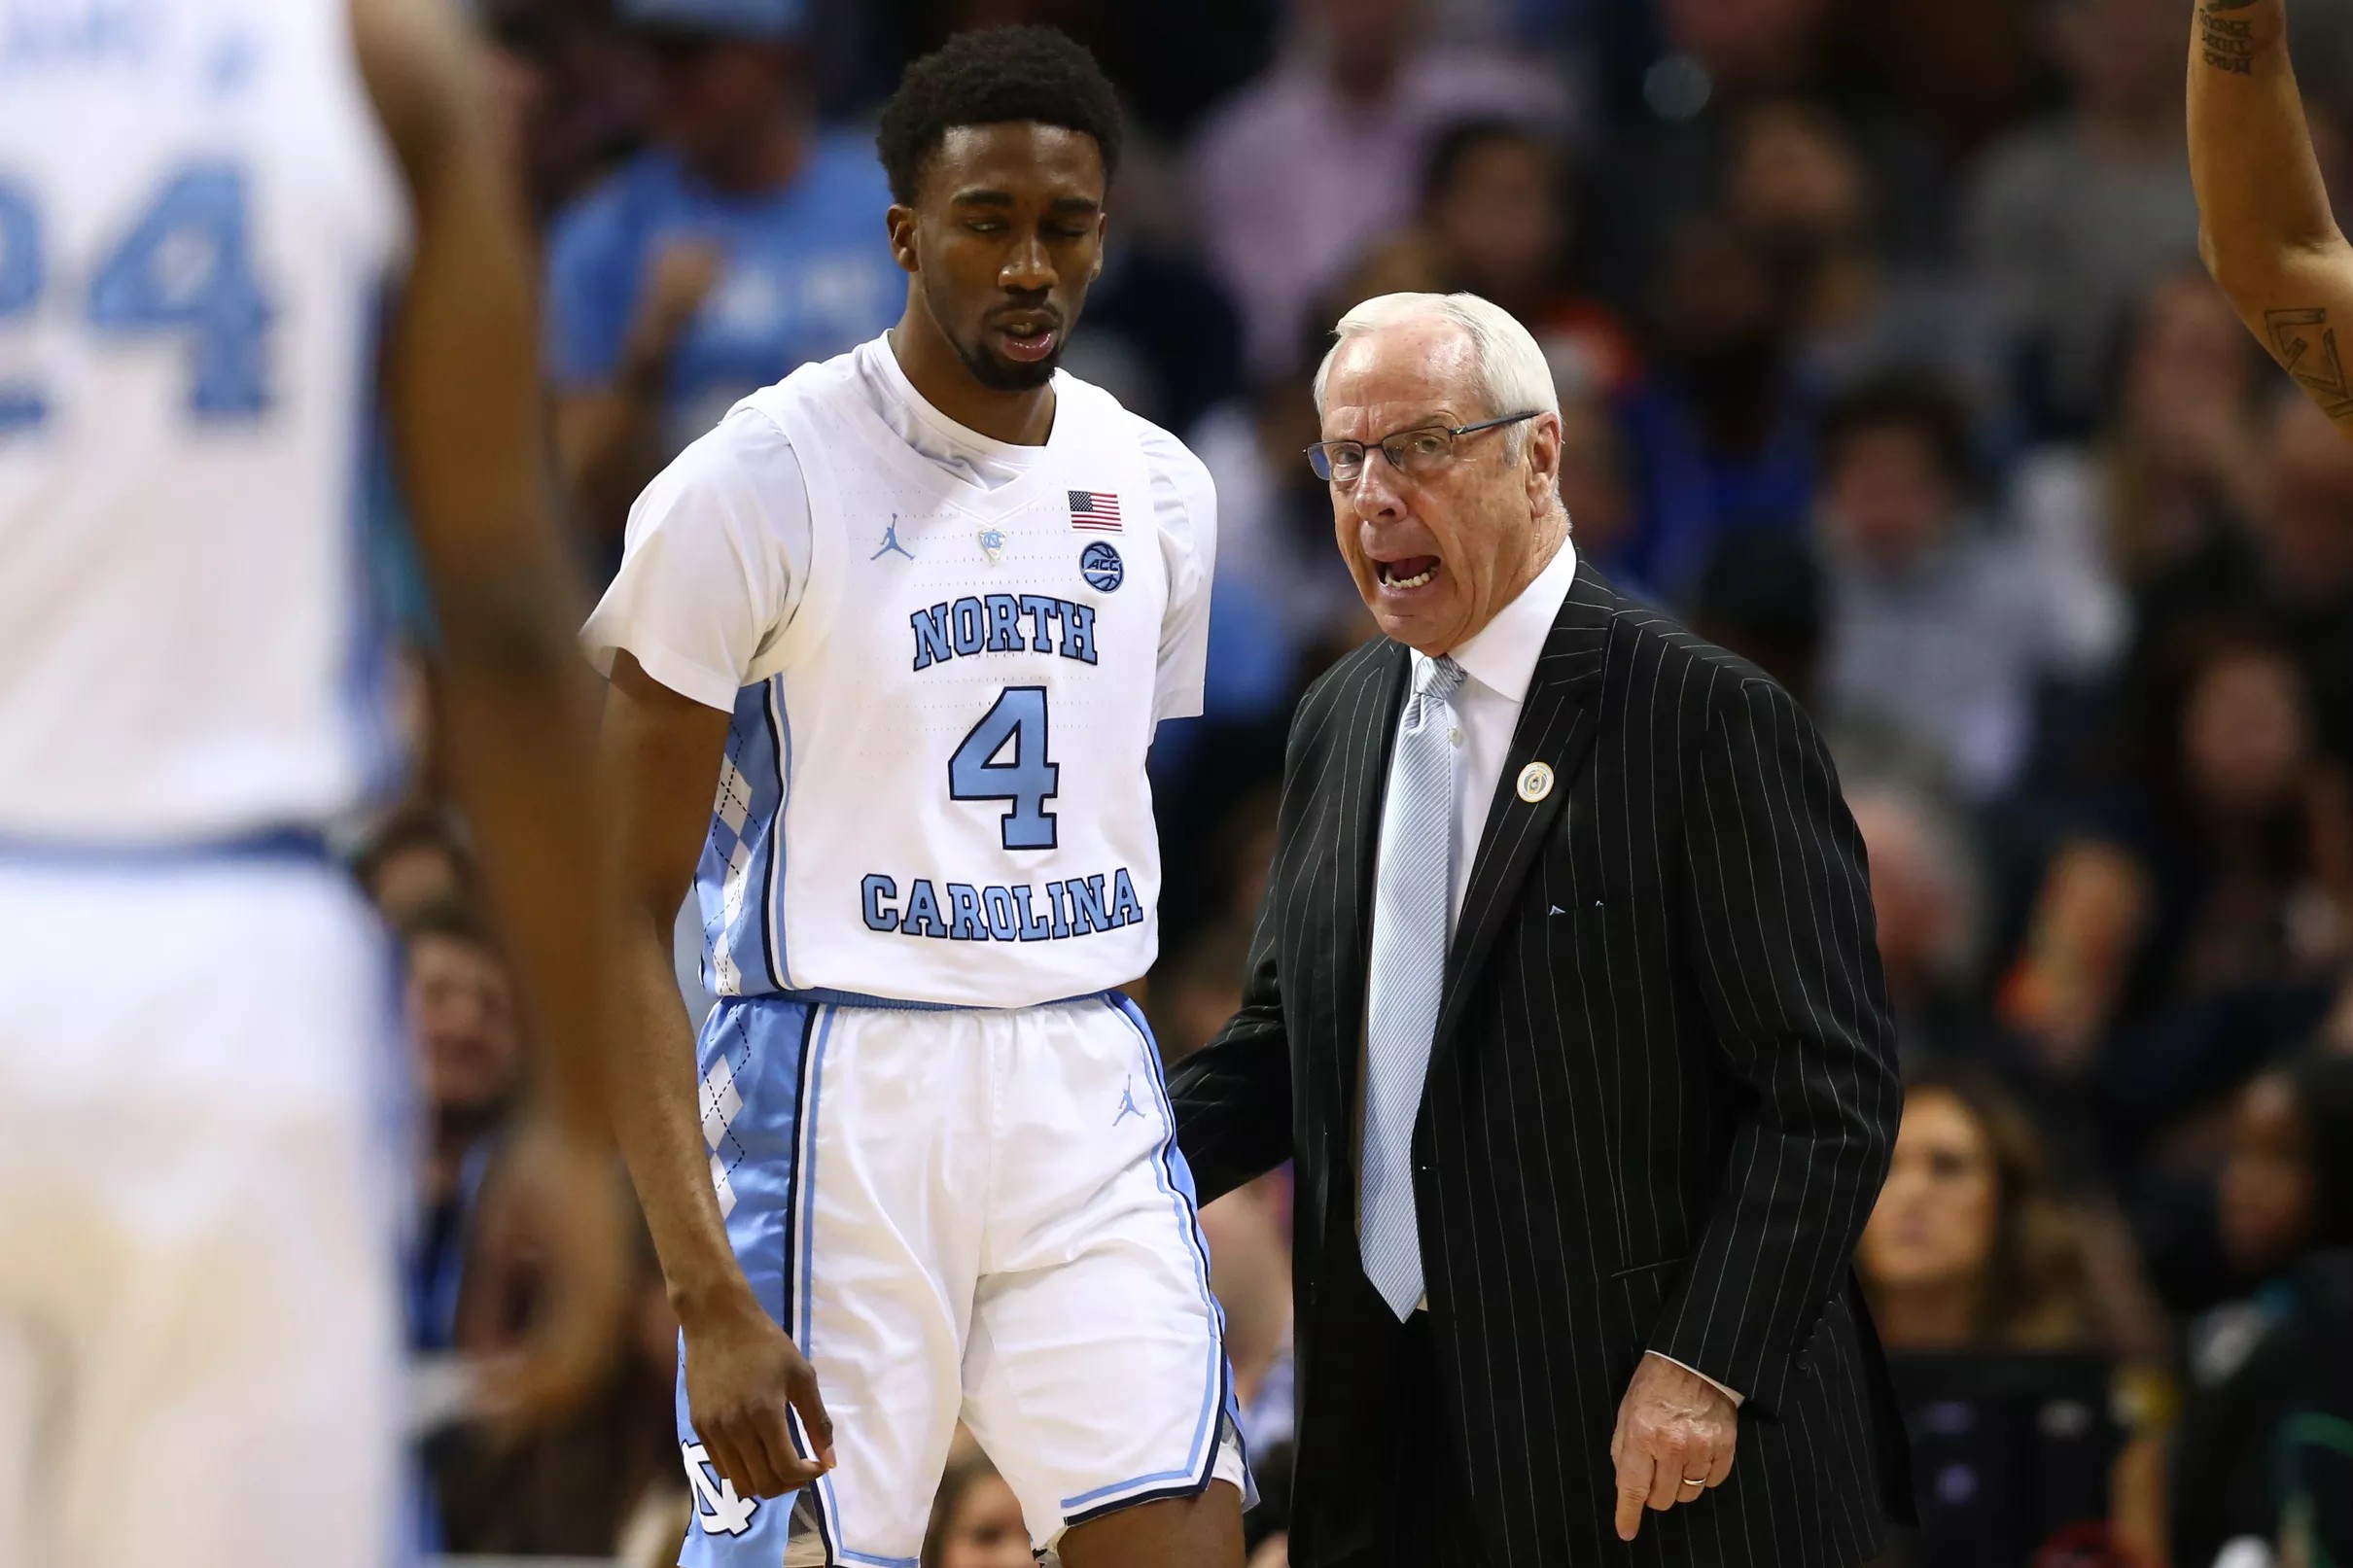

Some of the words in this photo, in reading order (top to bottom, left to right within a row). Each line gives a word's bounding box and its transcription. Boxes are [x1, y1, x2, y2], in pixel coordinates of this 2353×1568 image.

[1087, 559, 1120, 571] ACC
[910, 594, 1098, 671] NORTH
[948, 685, 1060, 850] 4
[860, 868, 1143, 942] CAROLINA
